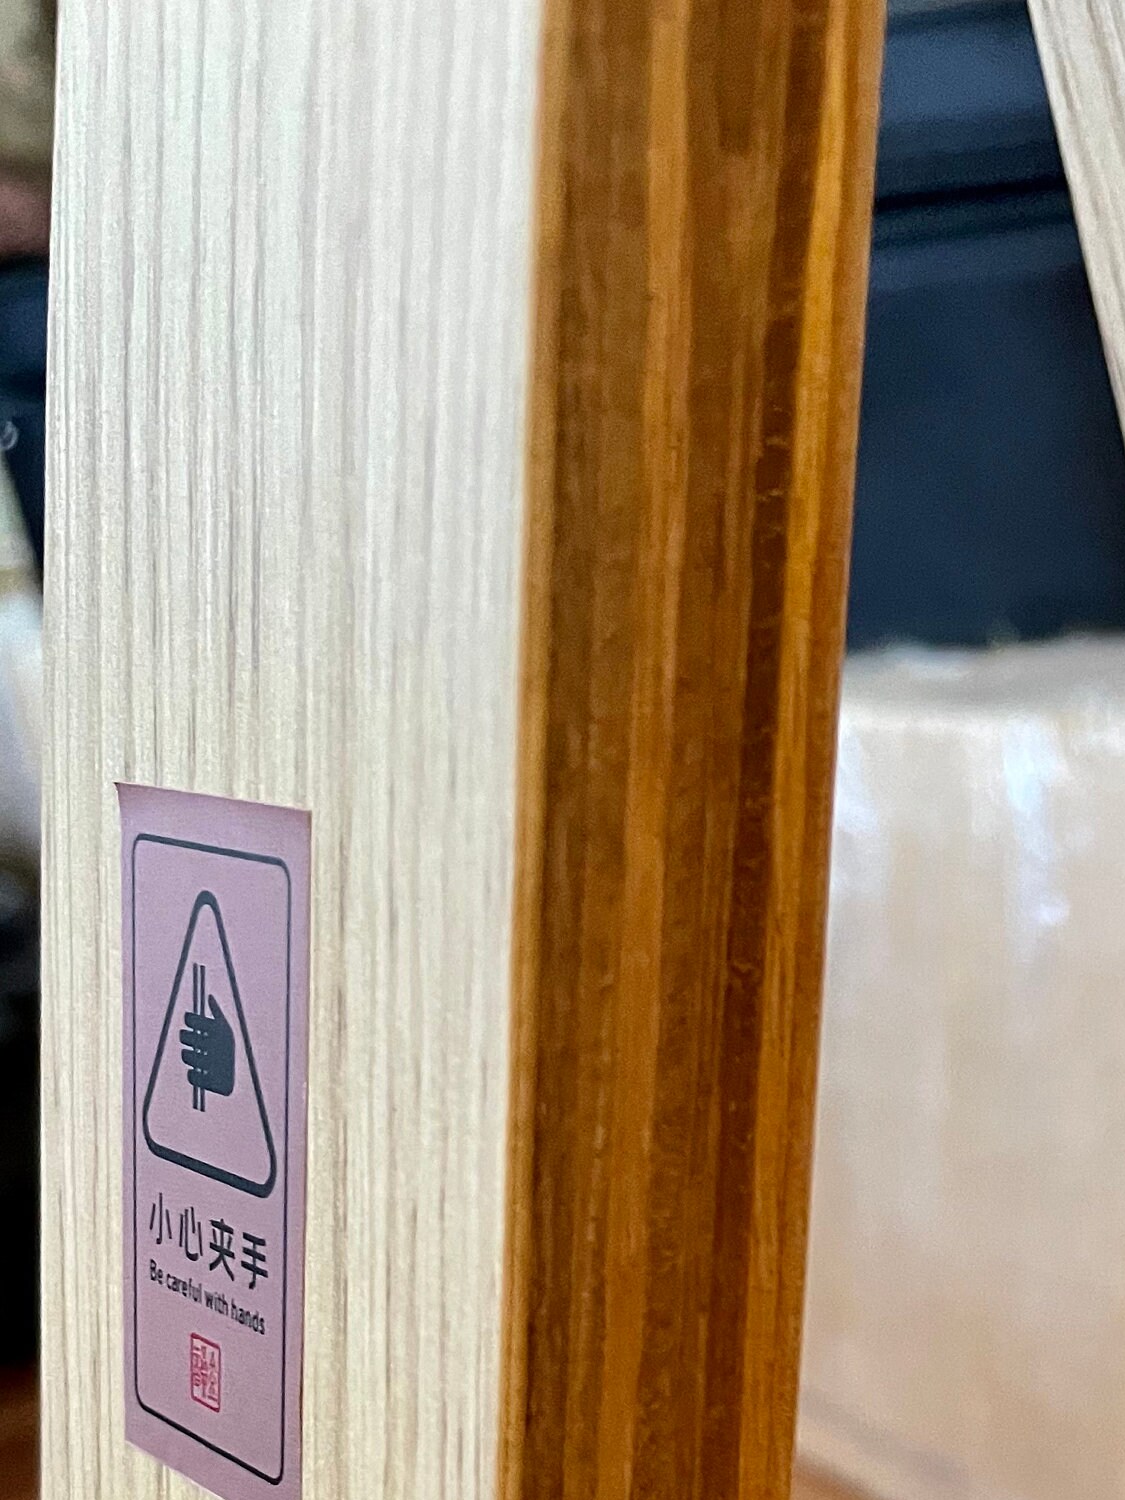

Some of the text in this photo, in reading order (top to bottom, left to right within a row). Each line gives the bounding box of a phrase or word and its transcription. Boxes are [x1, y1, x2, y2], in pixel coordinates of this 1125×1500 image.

[149, 1192, 269, 1290] 小心夹手
[149, 1258, 265, 1335] Be careful with hands
